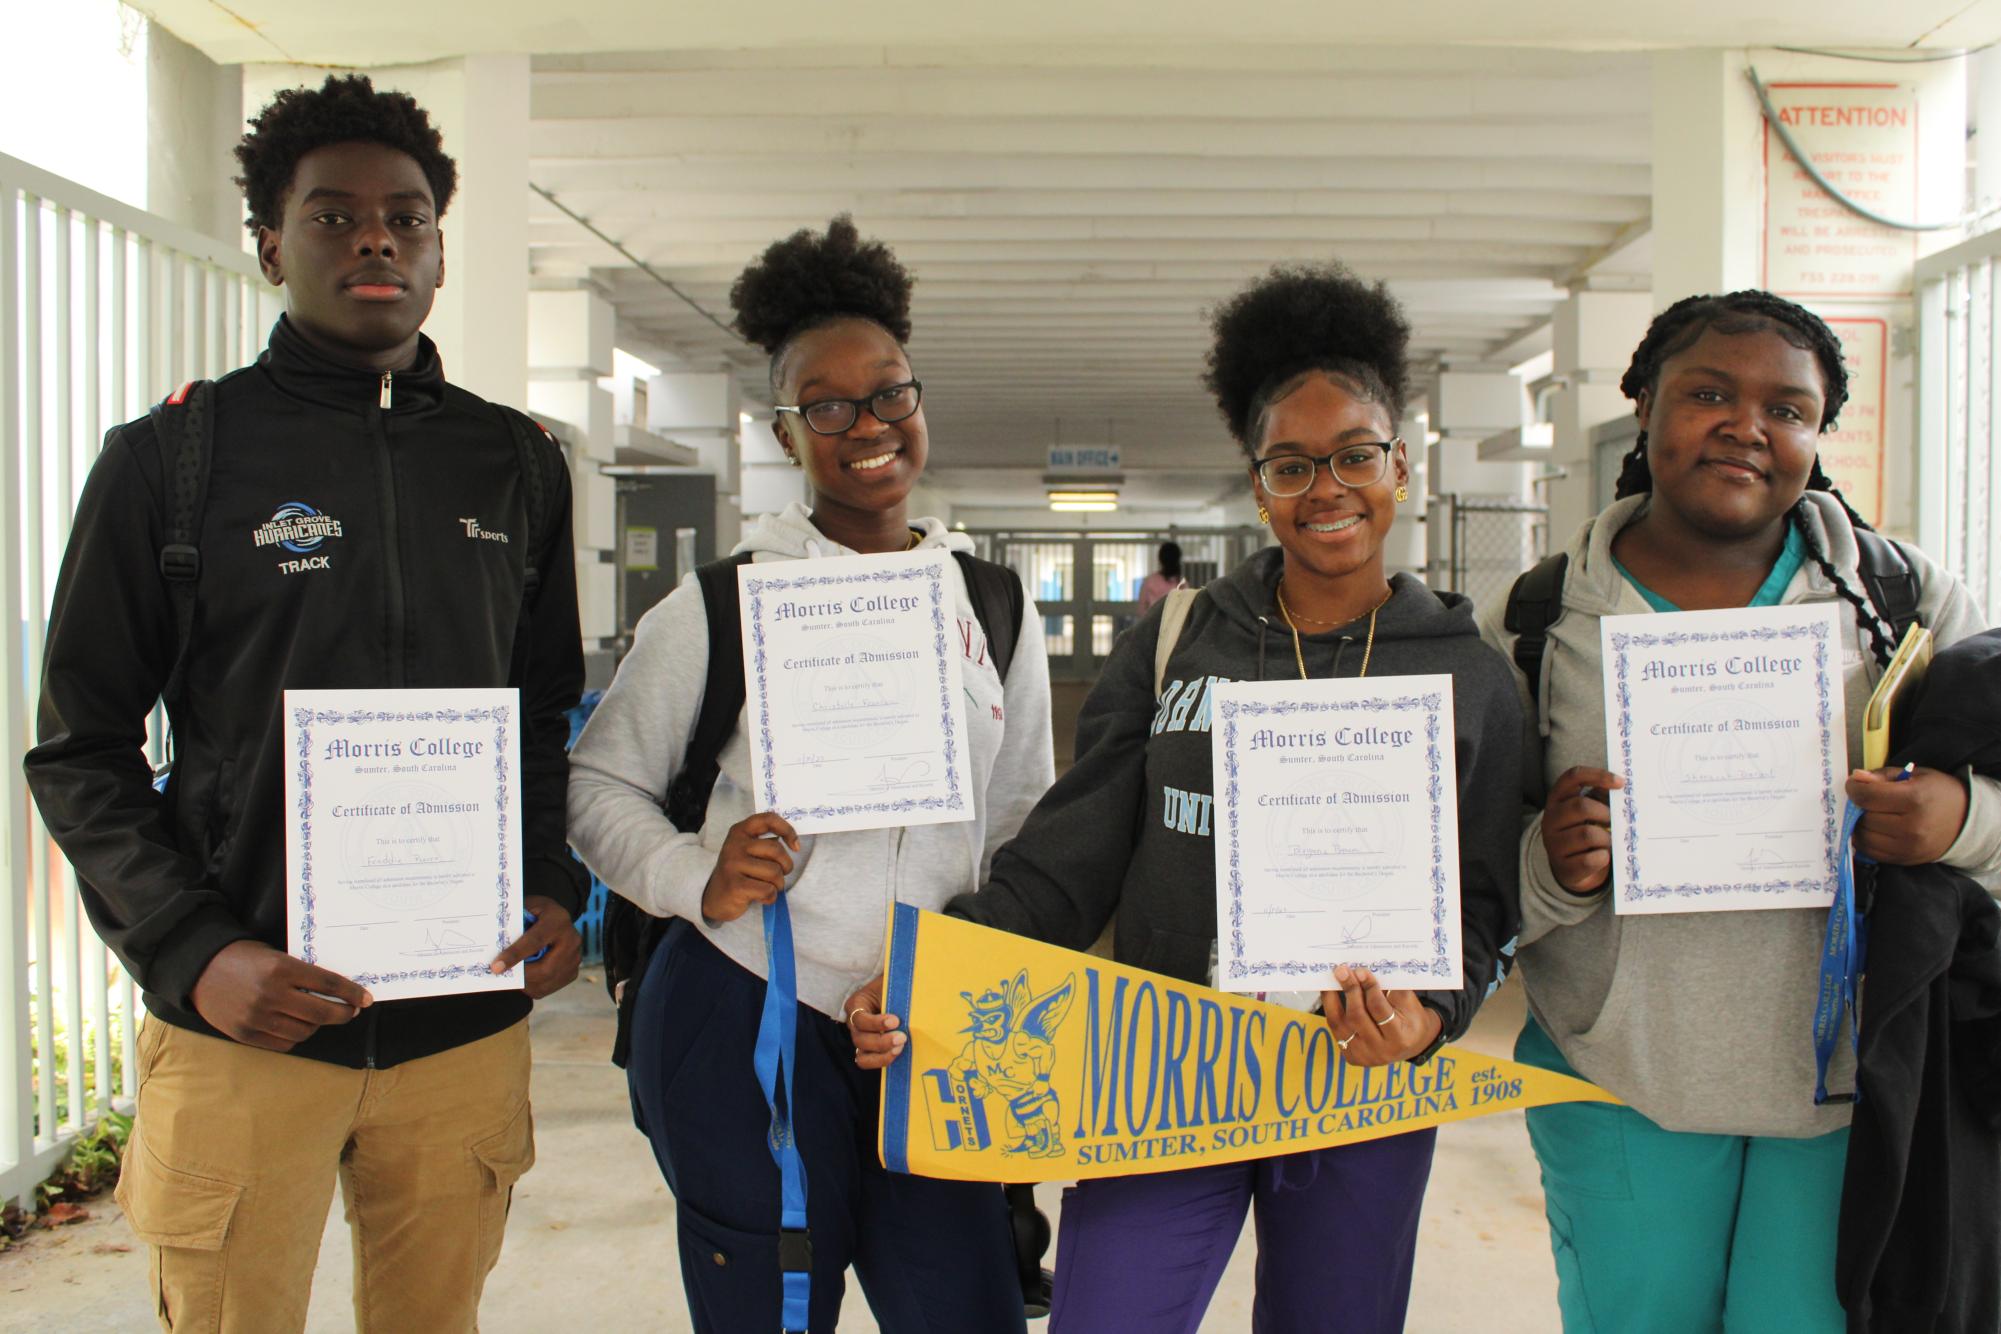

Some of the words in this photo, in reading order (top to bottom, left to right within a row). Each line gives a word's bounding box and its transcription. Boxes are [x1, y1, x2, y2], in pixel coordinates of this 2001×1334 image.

[1779, 106, 1907, 127] ATTENTION
[253, 520, 342, 547] HURRICANES
[262, 518, 294, 531] INLET
[295, 515, 331, 526] GROVE
[278, 556, 331, 575] TRACK
[774, 600, 843, 621] Morris
[850, 595, 919, 613] College
[783, 655, 841, 670] Certificate
[844, 653, 855, 665] of
[858, 649, 920, 664] Admission
[1641, 659, 1717, 681] Morris
[1724, 656, 1802, 676] College
[1650, 722, 1714, 736] Certificate
[1717, 720, 1729, 732] of
[1733, 718, 1800, 731] Admission
[324, 738, 401, 761] Morris
[409, 737, 484, 758] College
[1249, 729, 1326, 751] Morris
[1334, 727, 1413, 748] College
[392, 764, 419, 773] South
[421, 763, 457, 772] Carolina
[332, 804, 397, 818] Certificate
[400, 803, 412, 815] of
[415, 801, 480, 814] Admission
[1258, 794, 1321, 807] Certificate
[1326, 792, 1337, 805] of
[1342, 791, 1410, 804] Admission
[1163, 786, 1213, 836] UNI
[1073, 967, 1269, 1141] MORRIS
[1274, 1021, 1456, 1119] COLLEGE
[1470, 1064, 1502, 1084] est.
[1469, 1077, 1523, 1107] 1908
[1076, 1133, 1207, 1167] SUMTER,
[1211, 1116, 1309, 1150] SOUTH
[1316, 1091, 1459, 1135] CAROLINA
